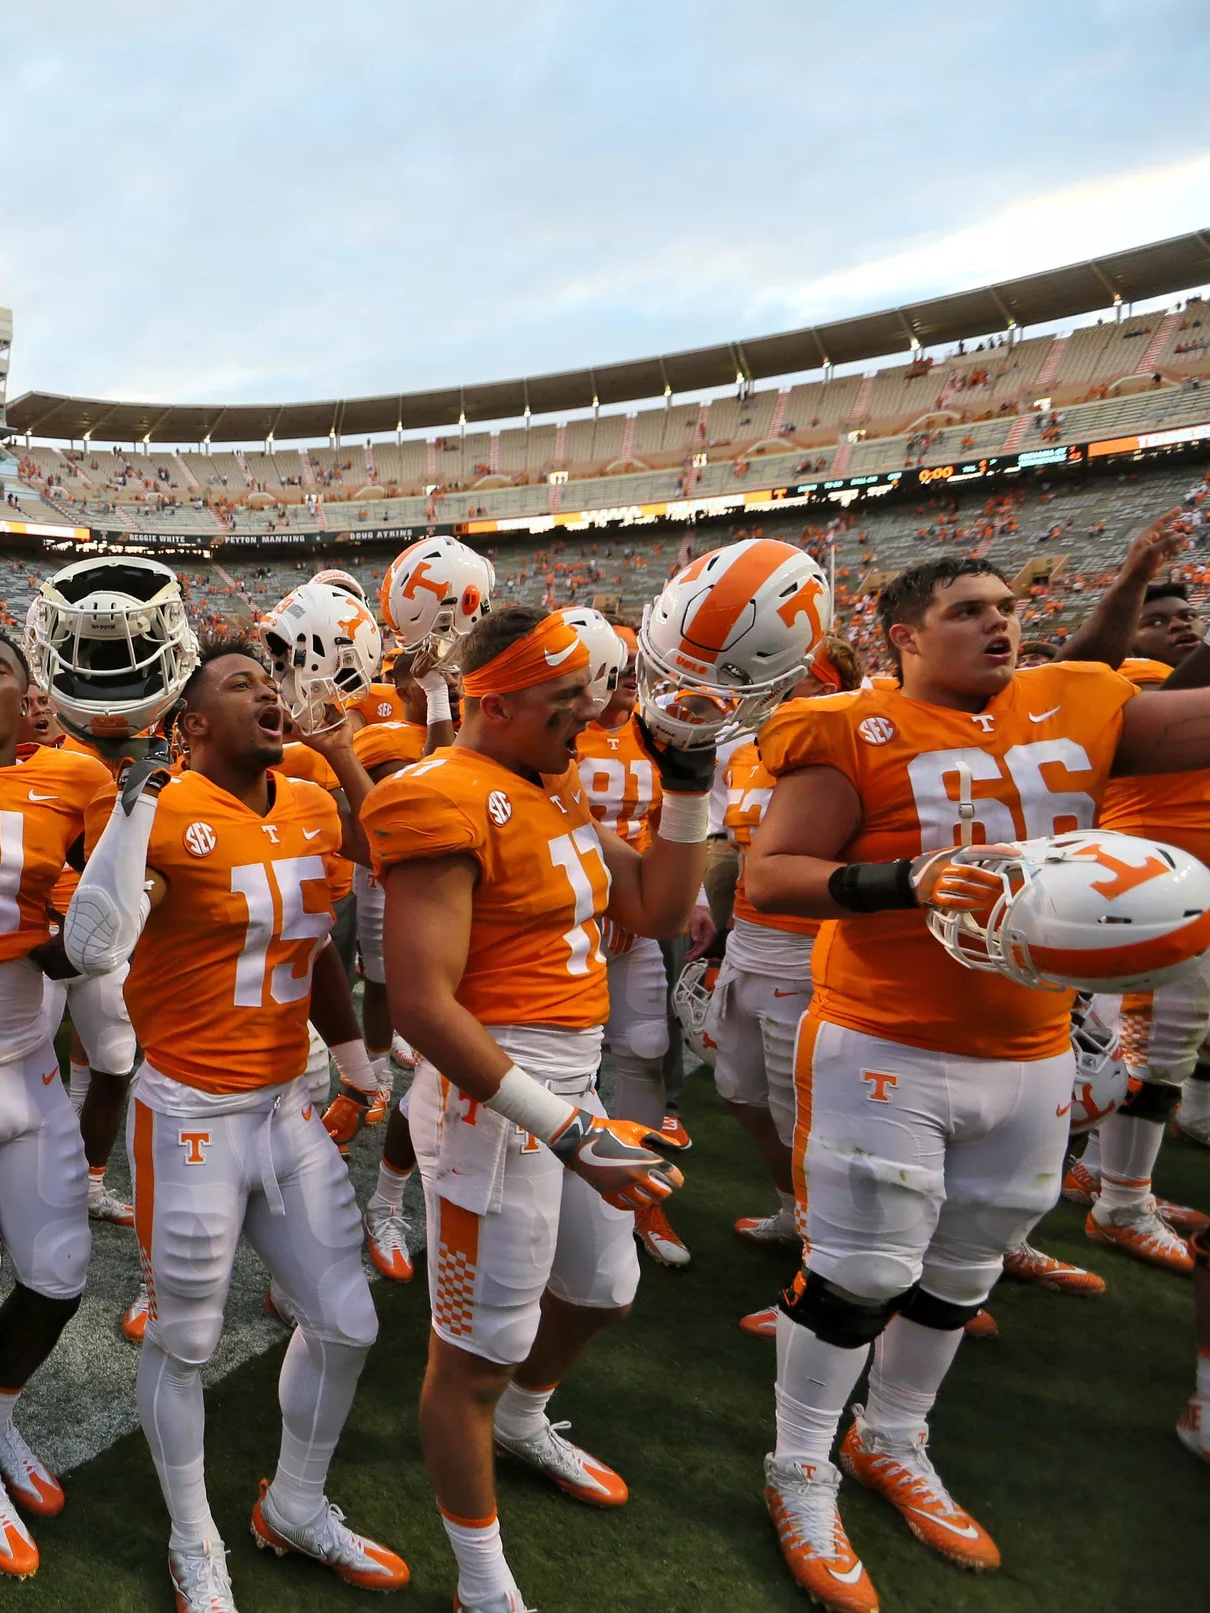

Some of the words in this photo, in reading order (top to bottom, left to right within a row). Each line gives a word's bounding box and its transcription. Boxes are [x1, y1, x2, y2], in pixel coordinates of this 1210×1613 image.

[919, 466, 954, 482] 0:00
[129, 533, 157, 542] REGGIE
[159, 535, 186, 543] WHITE
[225, 536, 257, 544] PEYTON
[261, 534, 305, 544] MANNING
[350, 531, 374, 540] DOUG
[376, 528, 413, 538] ATKINS
[402, 561, 450, 602] T
[777, 577, 825, 654] T
[377, 702, 393, 718] SEC
[655, 724, 677, 738] Riddell
[859, 717, 895, 744] SEC
[971, 714, 995, 732] T
[607, 738, 620, 751] T
[749, 765, 760, 778] T
[907, 737, 1097, 852] 66
[488, 790, 513, 826] SEC
[549, 795, 568, 814] T
[185, 823, 218, 856] SEC
[261, 824, 281, 844] T
[230, 855, 337, 1008] 15
[860, 1068, 899, 1104] T
[178, 1128, 214, 1167] T
[918, 1432, 927, 1445] T
[801, 1463, 817, 1480] T
